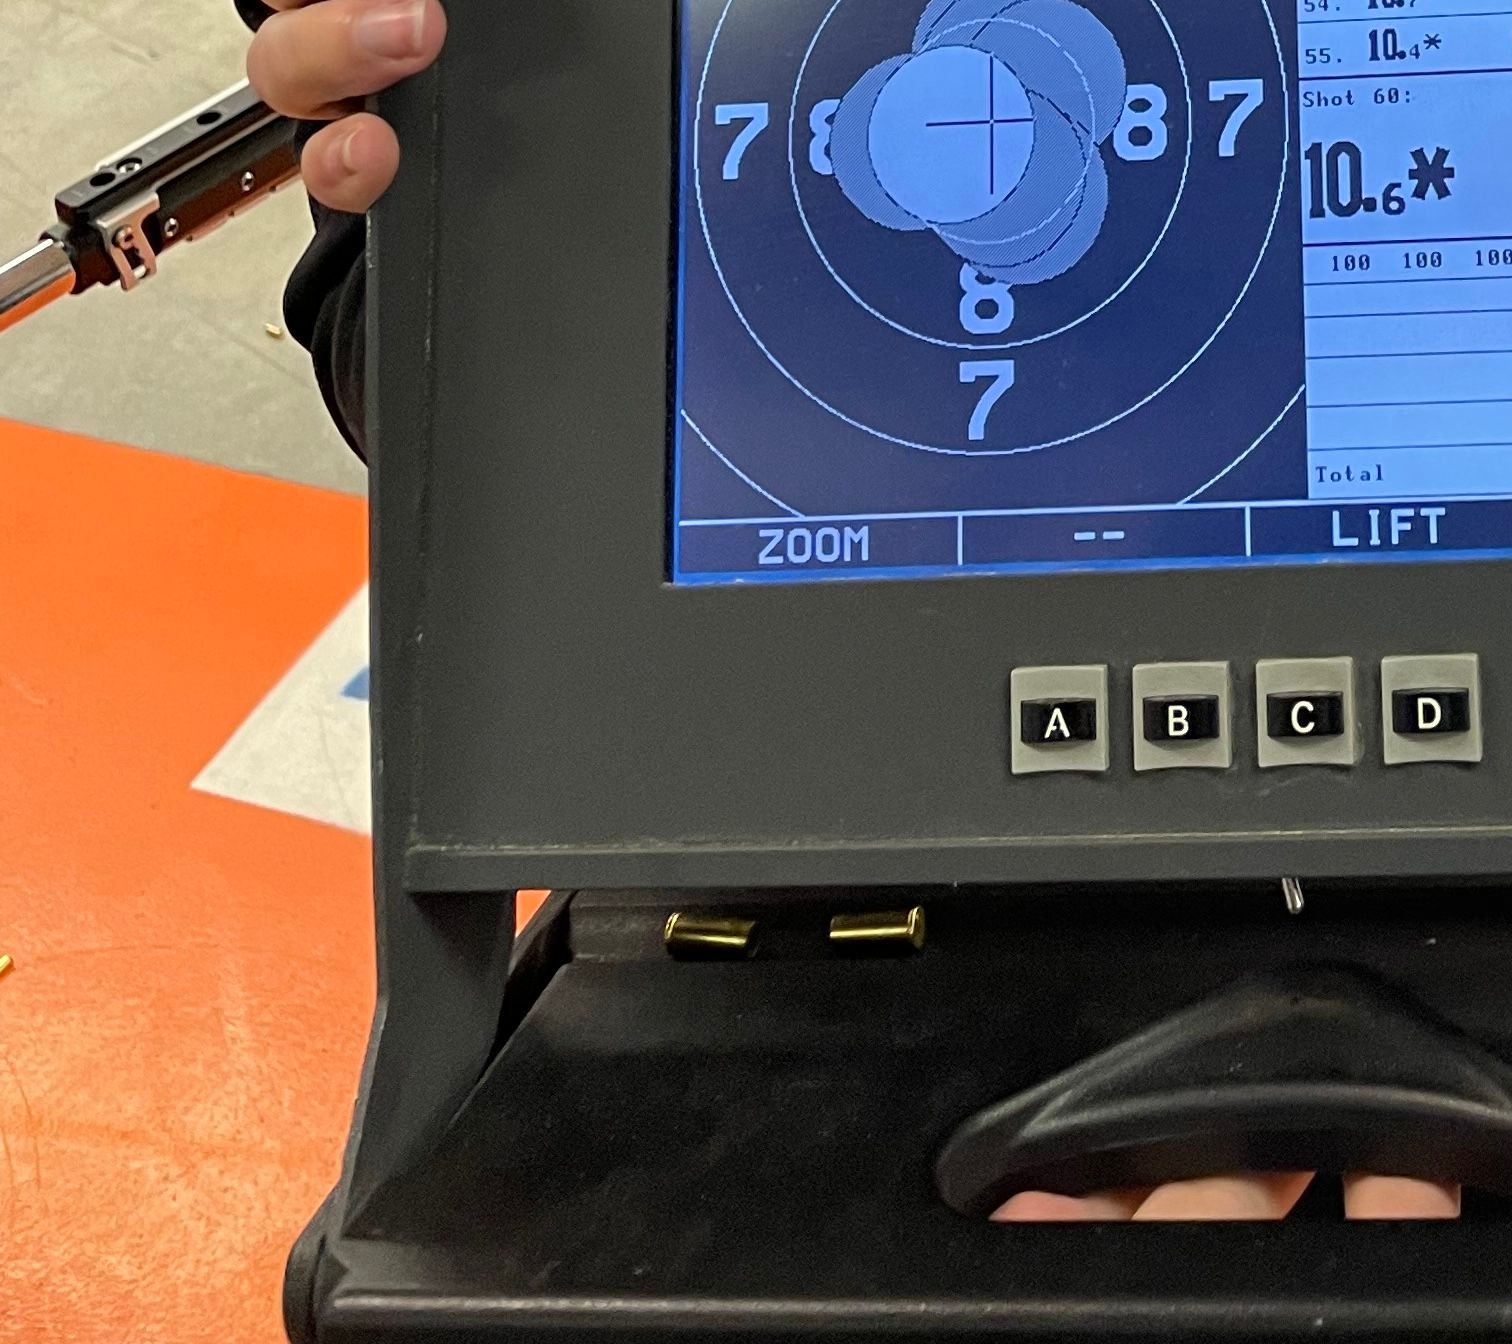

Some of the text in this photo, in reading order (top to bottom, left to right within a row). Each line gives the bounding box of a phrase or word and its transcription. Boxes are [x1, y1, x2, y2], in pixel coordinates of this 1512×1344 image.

[1305, 47, 1342, 65] 55.
[1302, 87, 1410, 108] Shot 60:
[1111, 83, 1169, 162] 8
[1208, 78, 1264, 157] 7
[714, 102, 769, 180] 7
[1332, 254, 1370, 272] 100
[1404, 251, 1442, 269] 100
[959, 262, 1016, 335] 8
[959, 359, 1015, 441] 7
[1315, 464, 1382, 483] Total
[1332, 507, 1446, 547] LIFT
[758, 525, 869, 565] ZOOM
[1044, 707, 1070, 739] A
[1168, 705, 1189, 736] B
[1291, 700, 1315, 734] C
[1417, 697, 1442, 729] D
